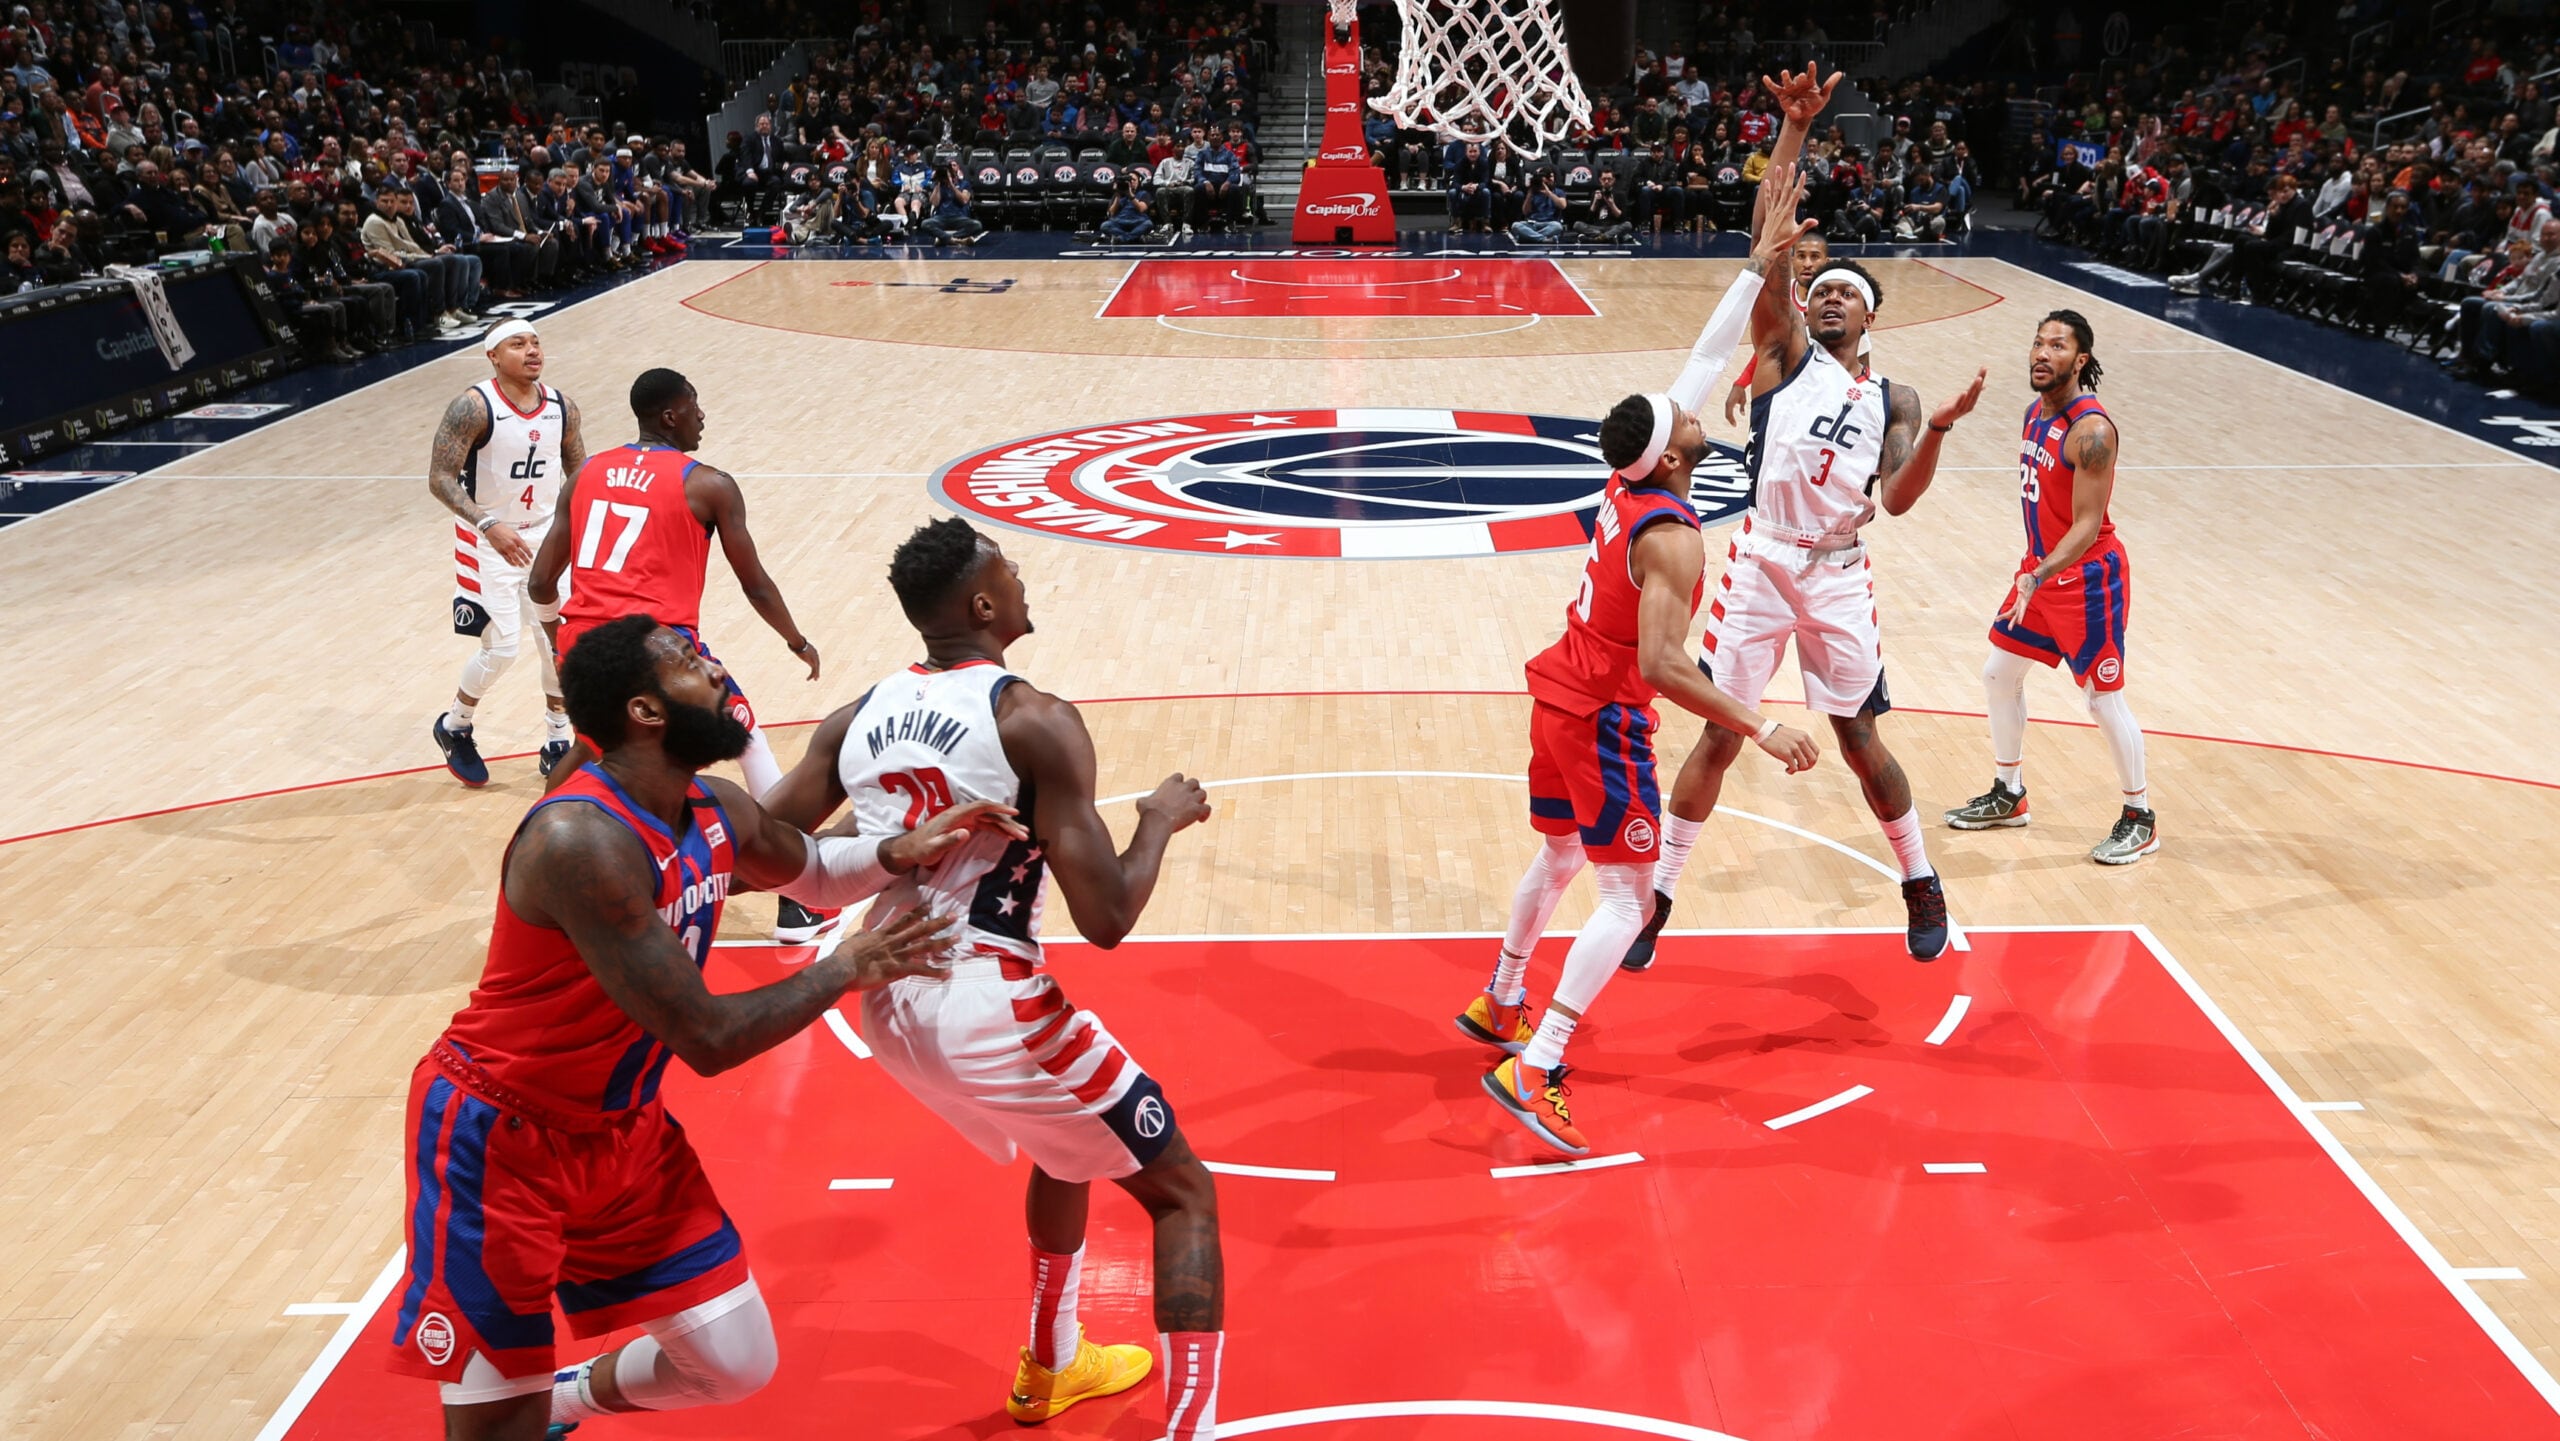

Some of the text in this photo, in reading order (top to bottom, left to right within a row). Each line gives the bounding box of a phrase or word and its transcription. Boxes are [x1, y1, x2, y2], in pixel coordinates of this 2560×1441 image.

[96, 329, 157, 360] Capital
[1810, 448, 1836, 487] 3
[2036, 446, 2056, 472] CITY
[520, 485, 534, 510] 4
[606, 467, 656, 493] SNELL
[967, 421, 1207, 540] WASHINGTON
[2020, 463, 2040, 503] 25
[577, 499, 650, 573] 17
[866, 709, 969, 760] MAHINMI
